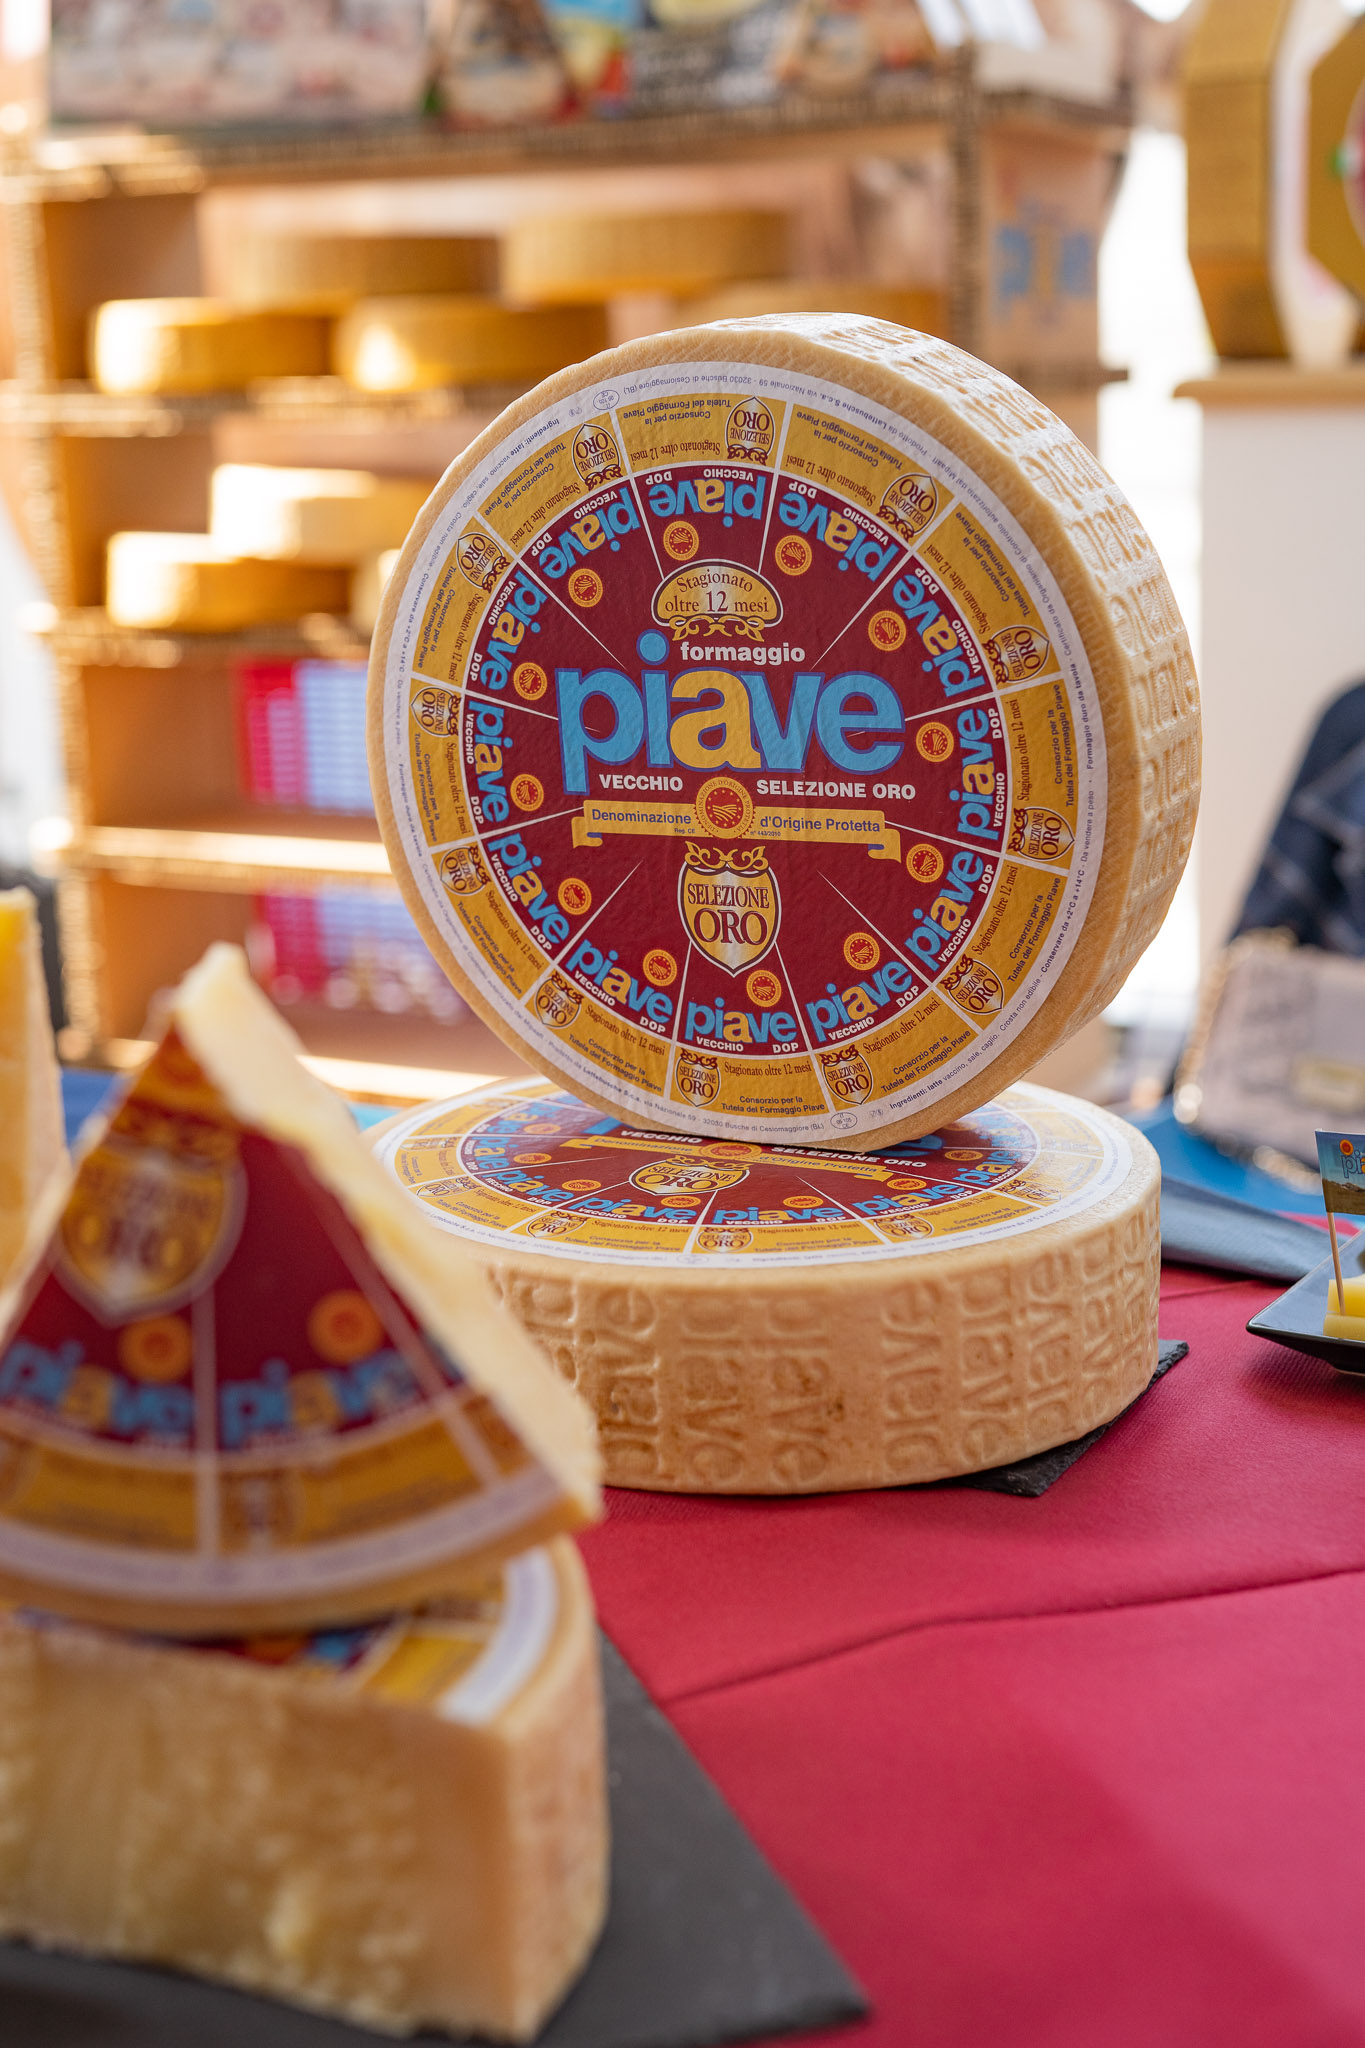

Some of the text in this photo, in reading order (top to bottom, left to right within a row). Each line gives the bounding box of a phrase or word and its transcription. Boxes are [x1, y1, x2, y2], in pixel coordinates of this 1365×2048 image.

[638, 374, 690, 390] Cesiomaggiore
[729, 375, 751, 384] 32030
[769, 380, 805, 394] Nazionale
[807, 389, 817, 397] via
[841, 402, 887, 429] Lattebusche
[897, 431, 928, 456] Prodotto
[644, 468, 754, 485] VECCHIO DOP
[955, 477, 967, 490] dal
[646, 474, 767, 527] piave
[788, 479, 891, 545] VECCHIO DOP
[965, 487, 999, 524] autorizzato
[528, 488, 618, 557] VECCHIO DOP
[538, 485, 640, 580] piave
[776, 492, 900, 582] piave
[996, 522, 1022, 556] Controllo
[676, 568, 754, 594] Stagionato
[1023, 562, 1051, 604] Organismo
[665, 590, 768, 614] oltre 12 mesi
[468, 577, 516, 681] VECCHIO DOP
[480, 568, 547, 692] piave
[891, 574, 986, 697] piave
[913, 565, 983, 674] VECCHIO DOP
[1050, 615, 1072, 656] Certificato
[680, 642, 805, 665] formaggio
[1069, 663, 1081, 688] tavola
[555, 628, 906, 796] piave
[1079, 703, 1088, 722] duro
[468, 699, 512, 824] piave
[1082, 724, 1094, 769] Formaggio
[465, 711, 484, 824] VECCHIO DOP
[949, 706, 999, 841] piave
[987, 707, 1004, 828] VECCHIO DOP
[599, 774, 916, 800] VECCHIO SELEZIONE ORO
[591, 809, 880, 832] Denominazione d'Origine Protetta
[1083, 818, 1092, 849] vendere
[487, 833, 569, 944] piave
[489, 853, 552, 951] VECCHIO DOP
[688, 883, 770, 909] SELEZIONE
[693, 909, 768, 945] ORO
[903, 850, 983, 972] piave
[937, 864, 995, 964] VECCHIO DOP
[1040, 931, 1064, 973] Conservare
[564, 939, 674, 1023] piave
[955, 966, 988, 1004] SELEZIONE
[968, 977, 998, 1011] ORO
[1023, 977, 1041, 1000] edibile
[572, 970, 665, 1034] VECCHIO DOP
[805, 960, 912, 1042] piave
[827, 984, 921, 1041] VECCHIO DOP
[1016, 999, 1027, 1012] non
[684, 997, 798, 1042] piave
[861, 996, 940, 1055] Stagionato oltre 12 mesi
[998, 1010, 1018, 1032] Crosta
[695, 1036, 799, 1053] VECCHIO DOP
[880, 1028, 971, 1092] Tutela del Formaggio Piave
[892, 1034, 948, 1075] Consorzio per la
[826, 1061, 865, 1082] SELEZIONE
[834, 1073, 869, 1096] ORO
[926, 1078, 942, 1090] latte
[620, 1130, 927, 1168] VECCHIO SELEZIONE ORO
[1341, 1150, 1365, 1178] pi
[638, 1174, 718, 1190] ORO
[648, 1166, 736, 1182] SELEZIONE
[824, 1163, 877, 1172] Protetta
[952, 1151, 1022, 1186] piave
[482, 1170, 574, 1201] piave
[852, 1184, 965, 1215] piave
[568, 1197, 697, 1219] piave
[578, 1208, 626, 1218] VECCHIO
[712, 1207, 844, 1224] piave
[880, 1203, 930, 1215] VECCHIO
[531, 1222, 567, 1235] ORO
[891, 1225, 929, 1236] ORO
